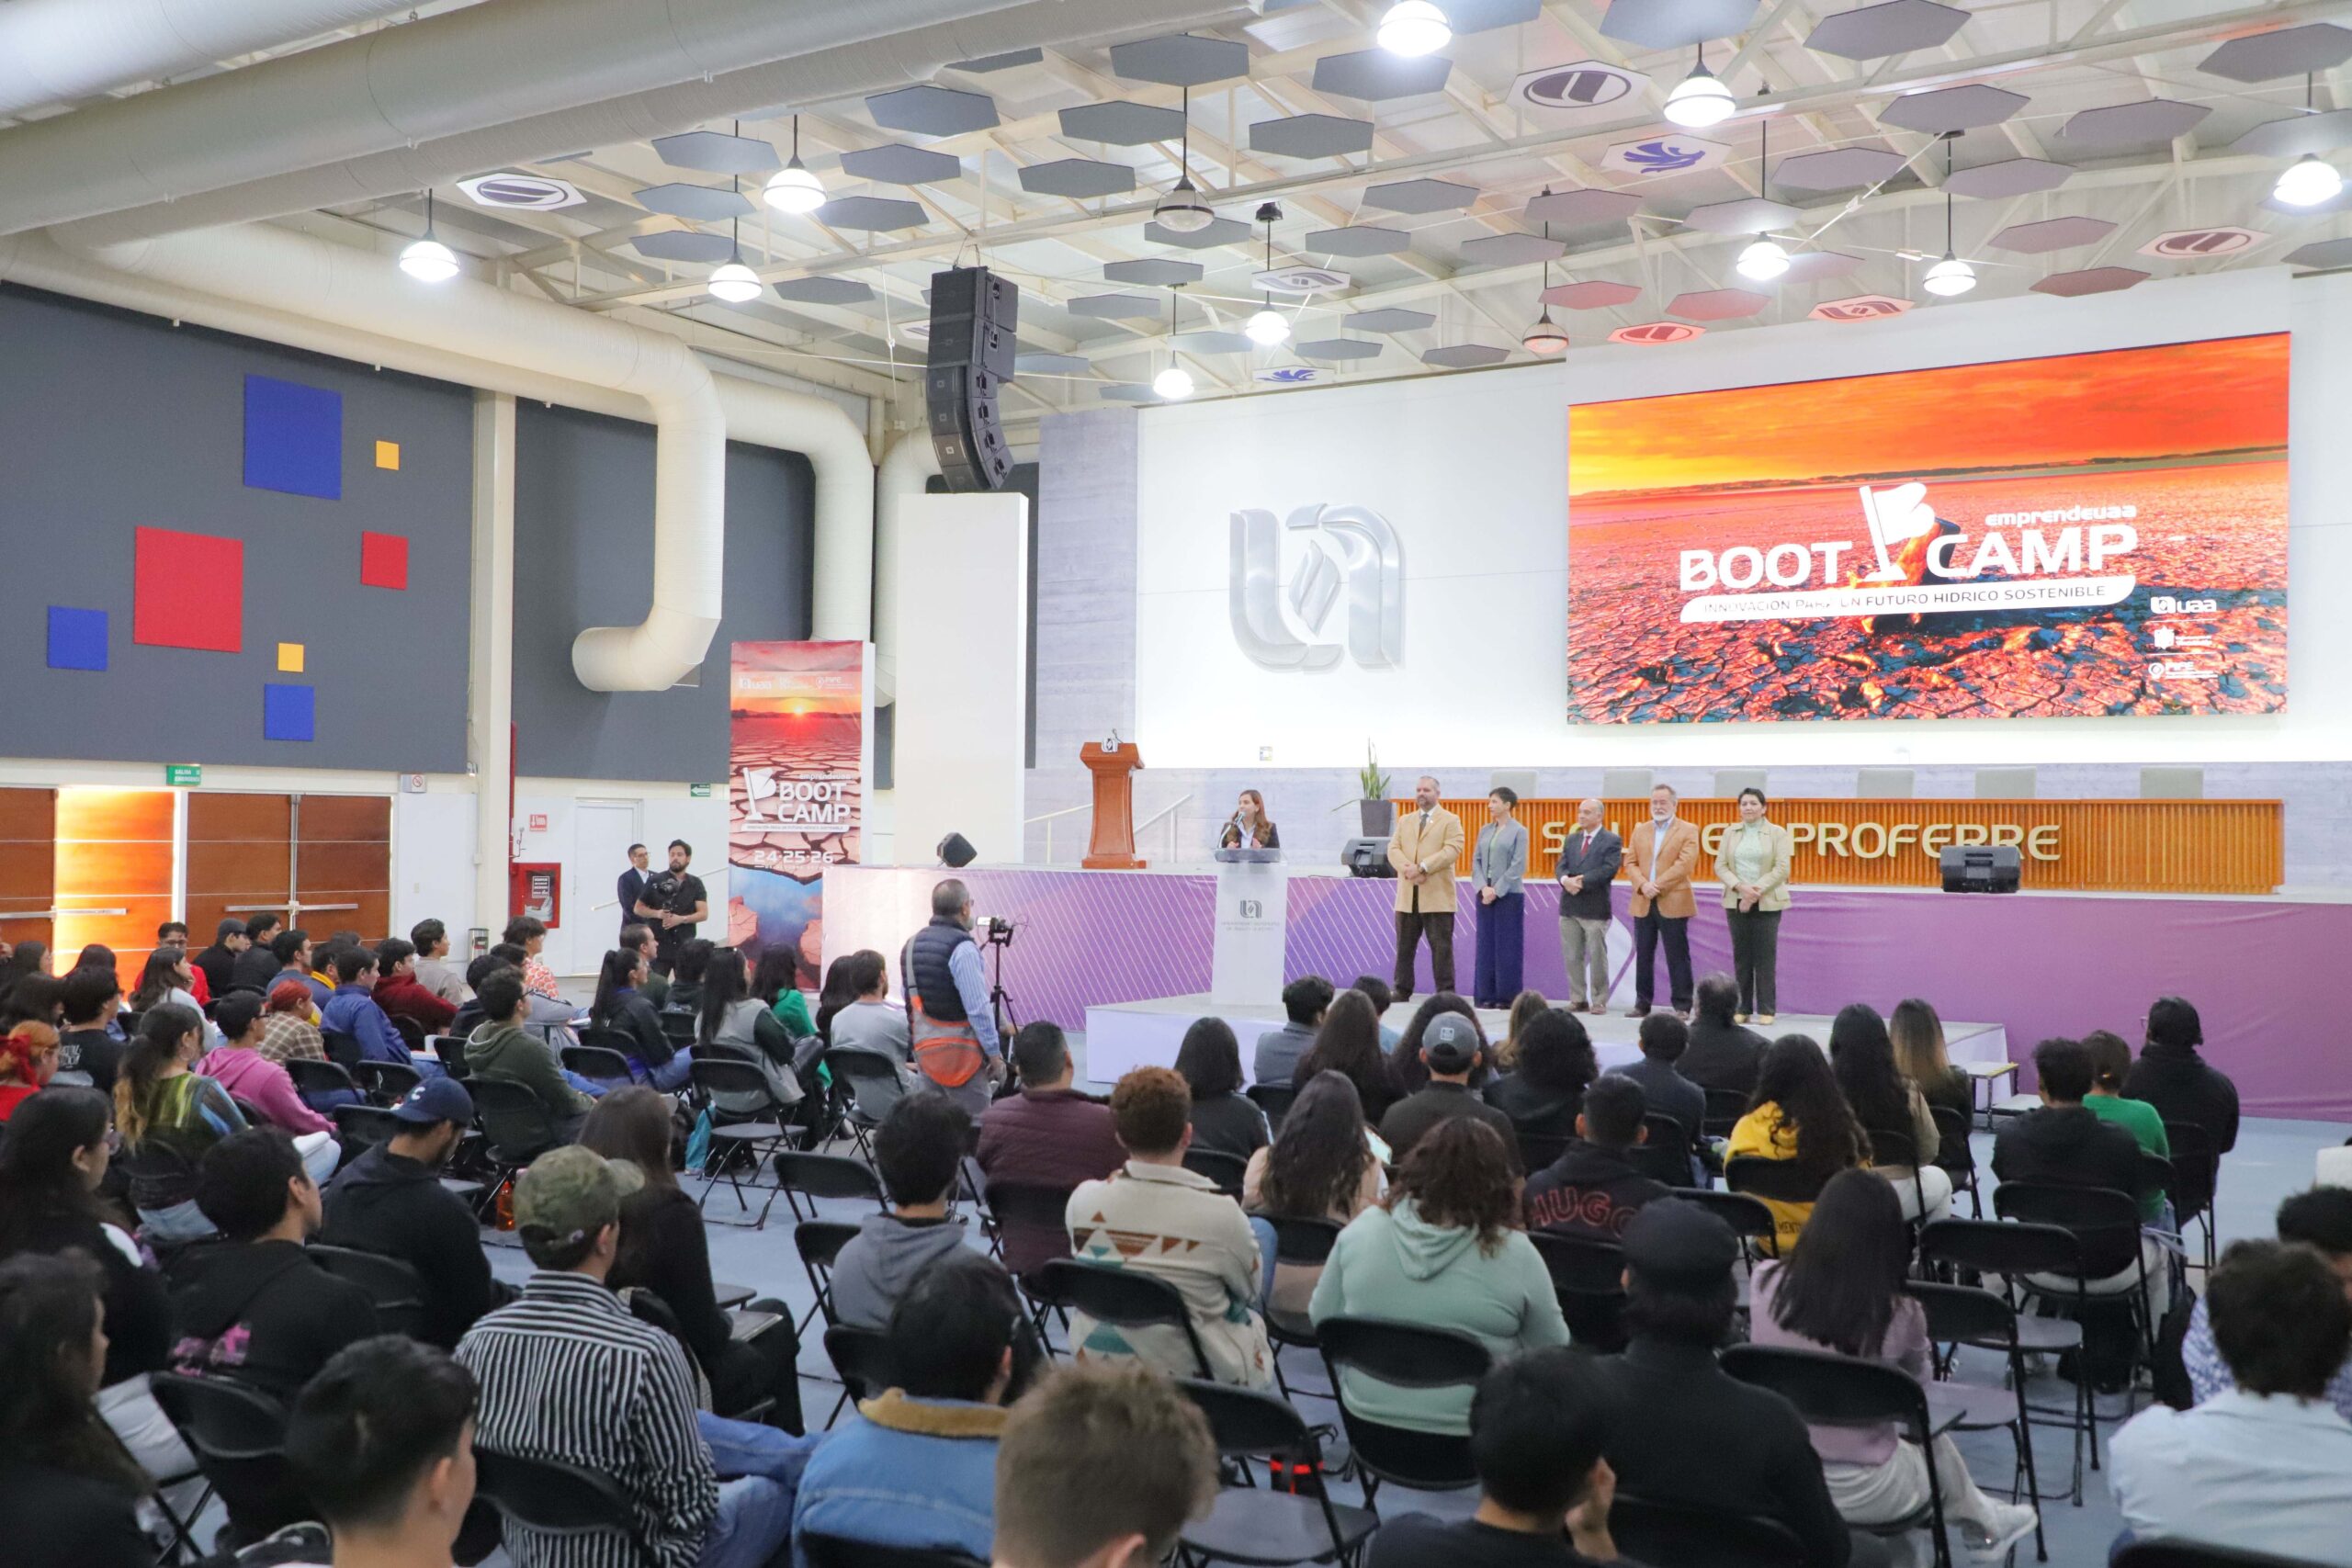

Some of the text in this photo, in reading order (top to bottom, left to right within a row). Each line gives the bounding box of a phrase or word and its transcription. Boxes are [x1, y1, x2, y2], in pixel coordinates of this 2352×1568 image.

[1984, 505, 2137, 527] emprendeuaa
[1679, 525, 2138, 591] BOOT CAMP
[1866, 592, 1928, 607] FUTURO
[1933, 590, 1999, 604] HIDRICO
[2004, 585, 2107, 602] SOSTENIBLE
[779, 781, 848, 802] BOOT
[777, 803, 851, 823] CAMP
[1786, 821, 2062, 861] PROFERRE
